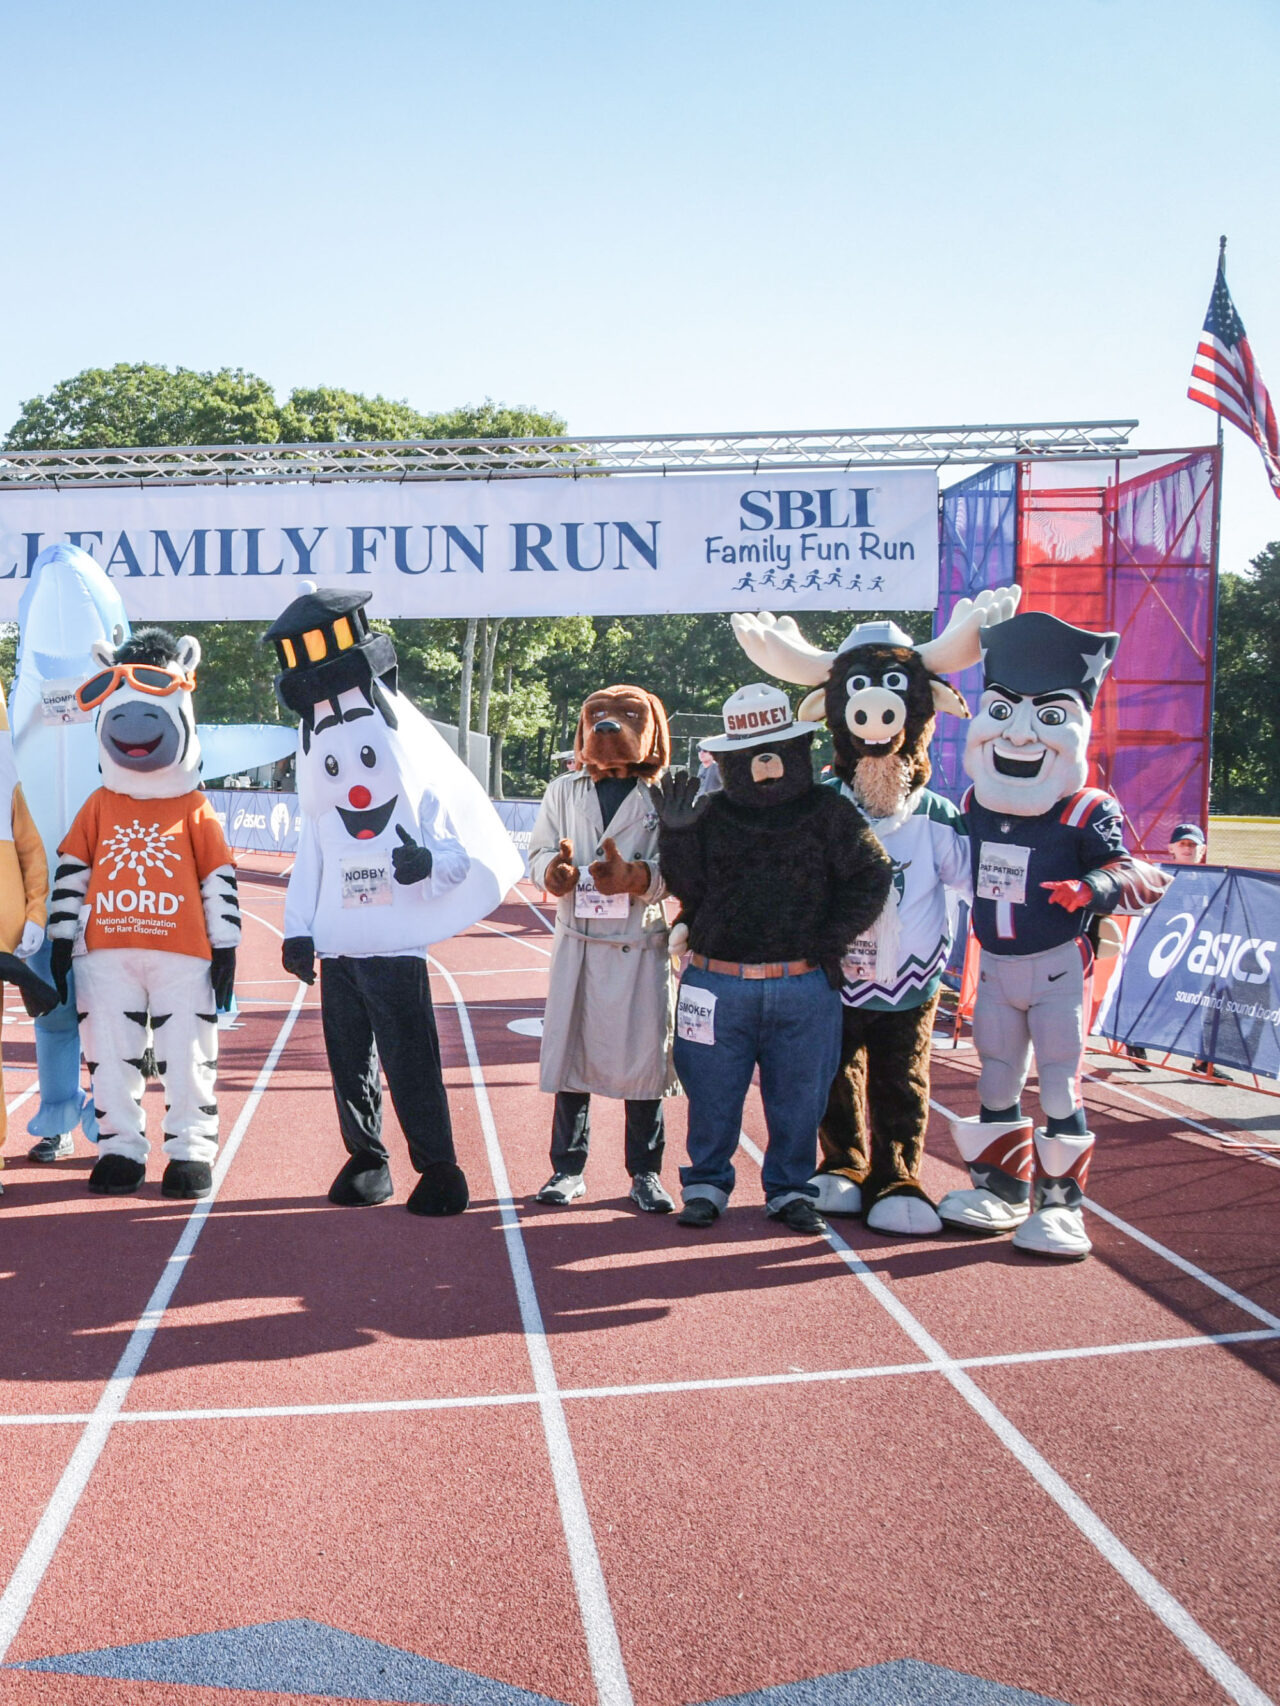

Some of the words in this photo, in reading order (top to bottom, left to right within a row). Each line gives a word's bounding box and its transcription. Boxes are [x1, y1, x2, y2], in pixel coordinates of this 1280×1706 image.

[739, 487, 875, 531] SBLI
[346, 524, 490, 576] FUN
[510, 519, 662, 572] RUN
[705, 534, 791, 570] Family
[800, 533, 850, 561] Fun
[859, 532, 915, 561] Run
[727, 706, 787, 731] SMOKEY
[243, 813, 266, 830] asics
[345, 868, 385, 882] NOBBY
[980, 863, 992, 872] PAT
[993, 866, 1025, 877] PATRIOT
[96, 889, 180, 915] NORD
[96, 917, 128, 927] National
[128, 916, 176, 929] Organization
[104, 925, 115, 934] for
[117, 924, 132, 933] Rare
[134, 925, 168, 936] Disorders
[1187, 930, 1277, 985] asics
[679, 1002, 712, 1017] SMOKEY
[1175, 990, 1201, 1006] sound
[1226, 1000, 1256, 1017] sound
